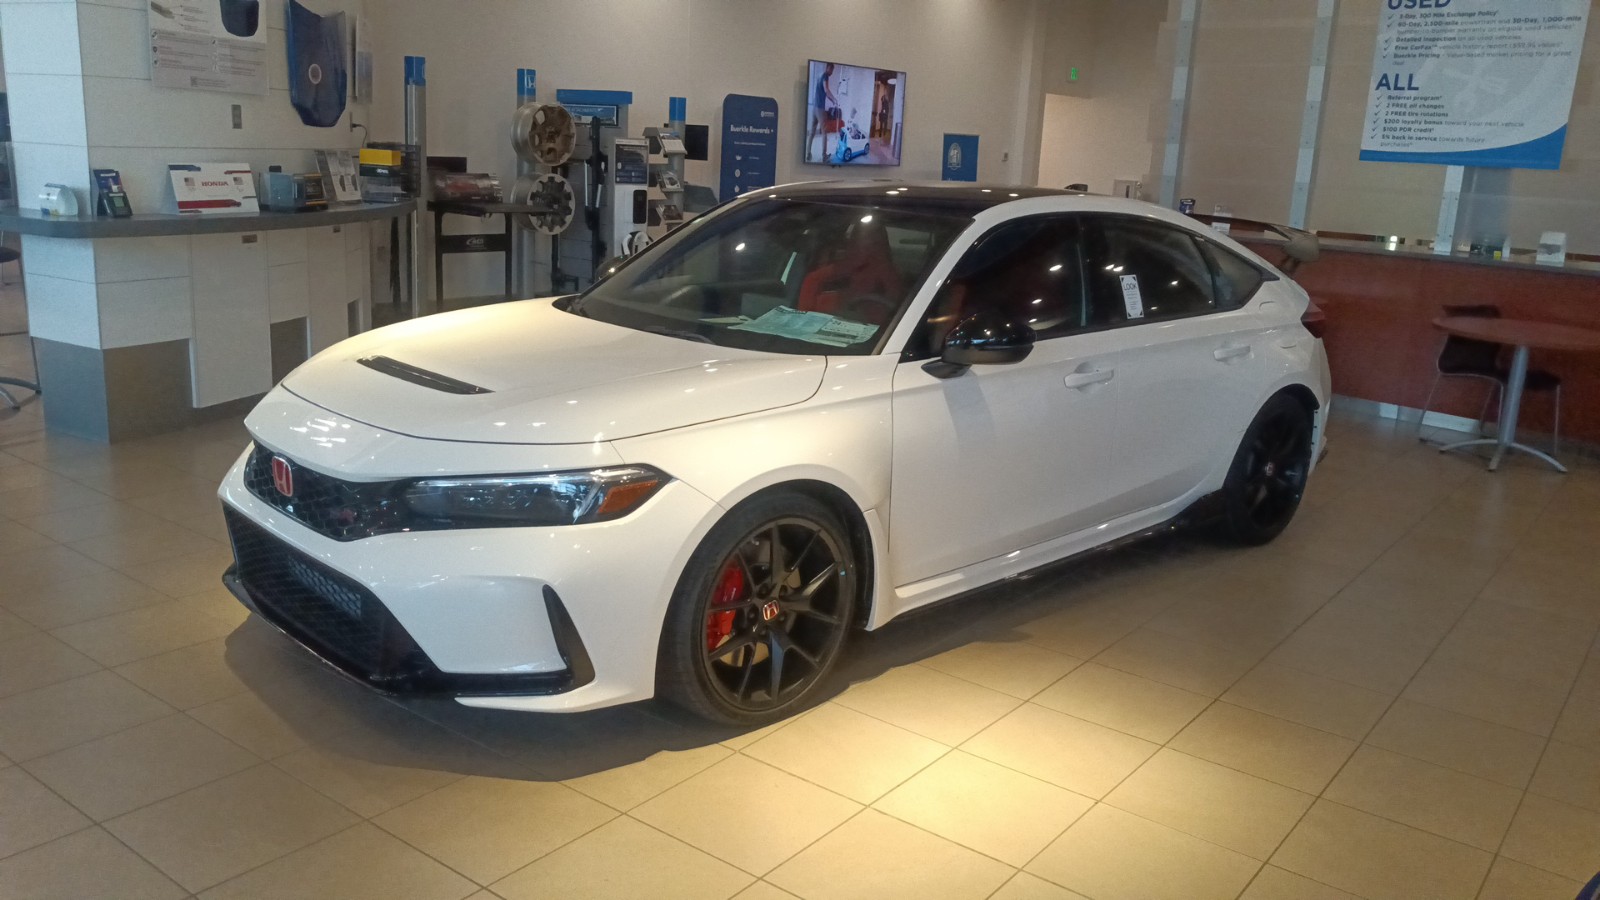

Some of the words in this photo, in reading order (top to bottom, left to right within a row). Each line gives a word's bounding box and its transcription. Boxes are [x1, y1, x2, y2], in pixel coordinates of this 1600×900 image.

[1375, 73, 1419, 91] ALL
[749, 125, 770, 134] Rewards
[1123, 283, 1138, 291] LOOK
